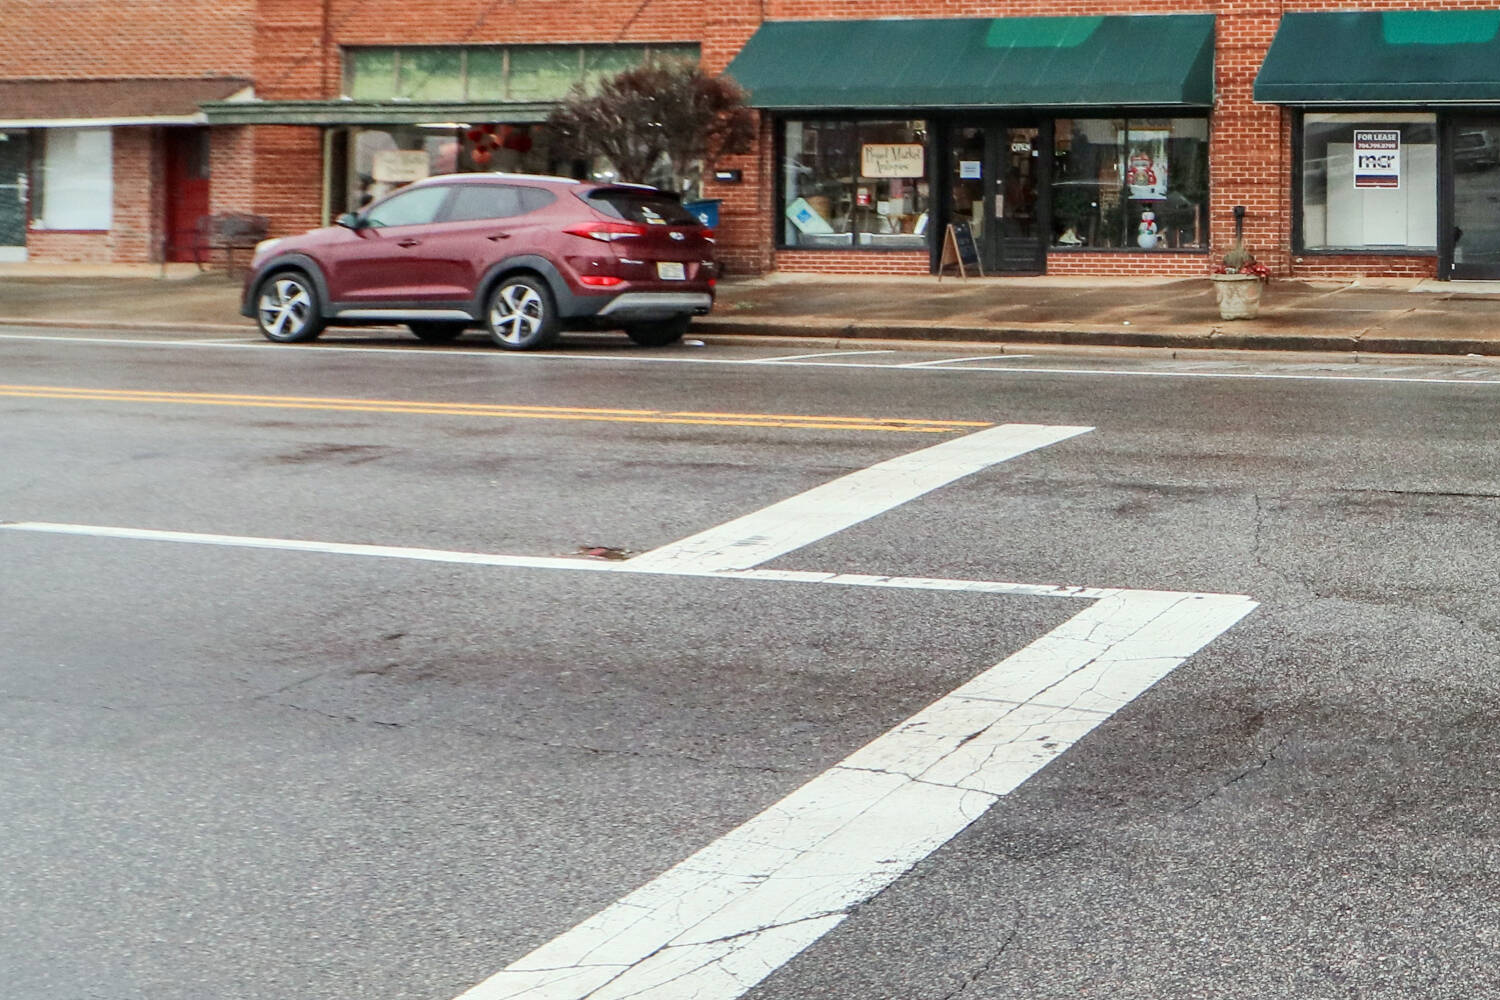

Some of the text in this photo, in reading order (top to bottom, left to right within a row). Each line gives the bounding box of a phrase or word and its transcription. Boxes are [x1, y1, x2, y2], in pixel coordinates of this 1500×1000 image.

[1357, 133, 1397, 141] FOR LEASE
[1011, 143, 1031, 152] OPEN
[1358, 155, 1395, 168] mcr
